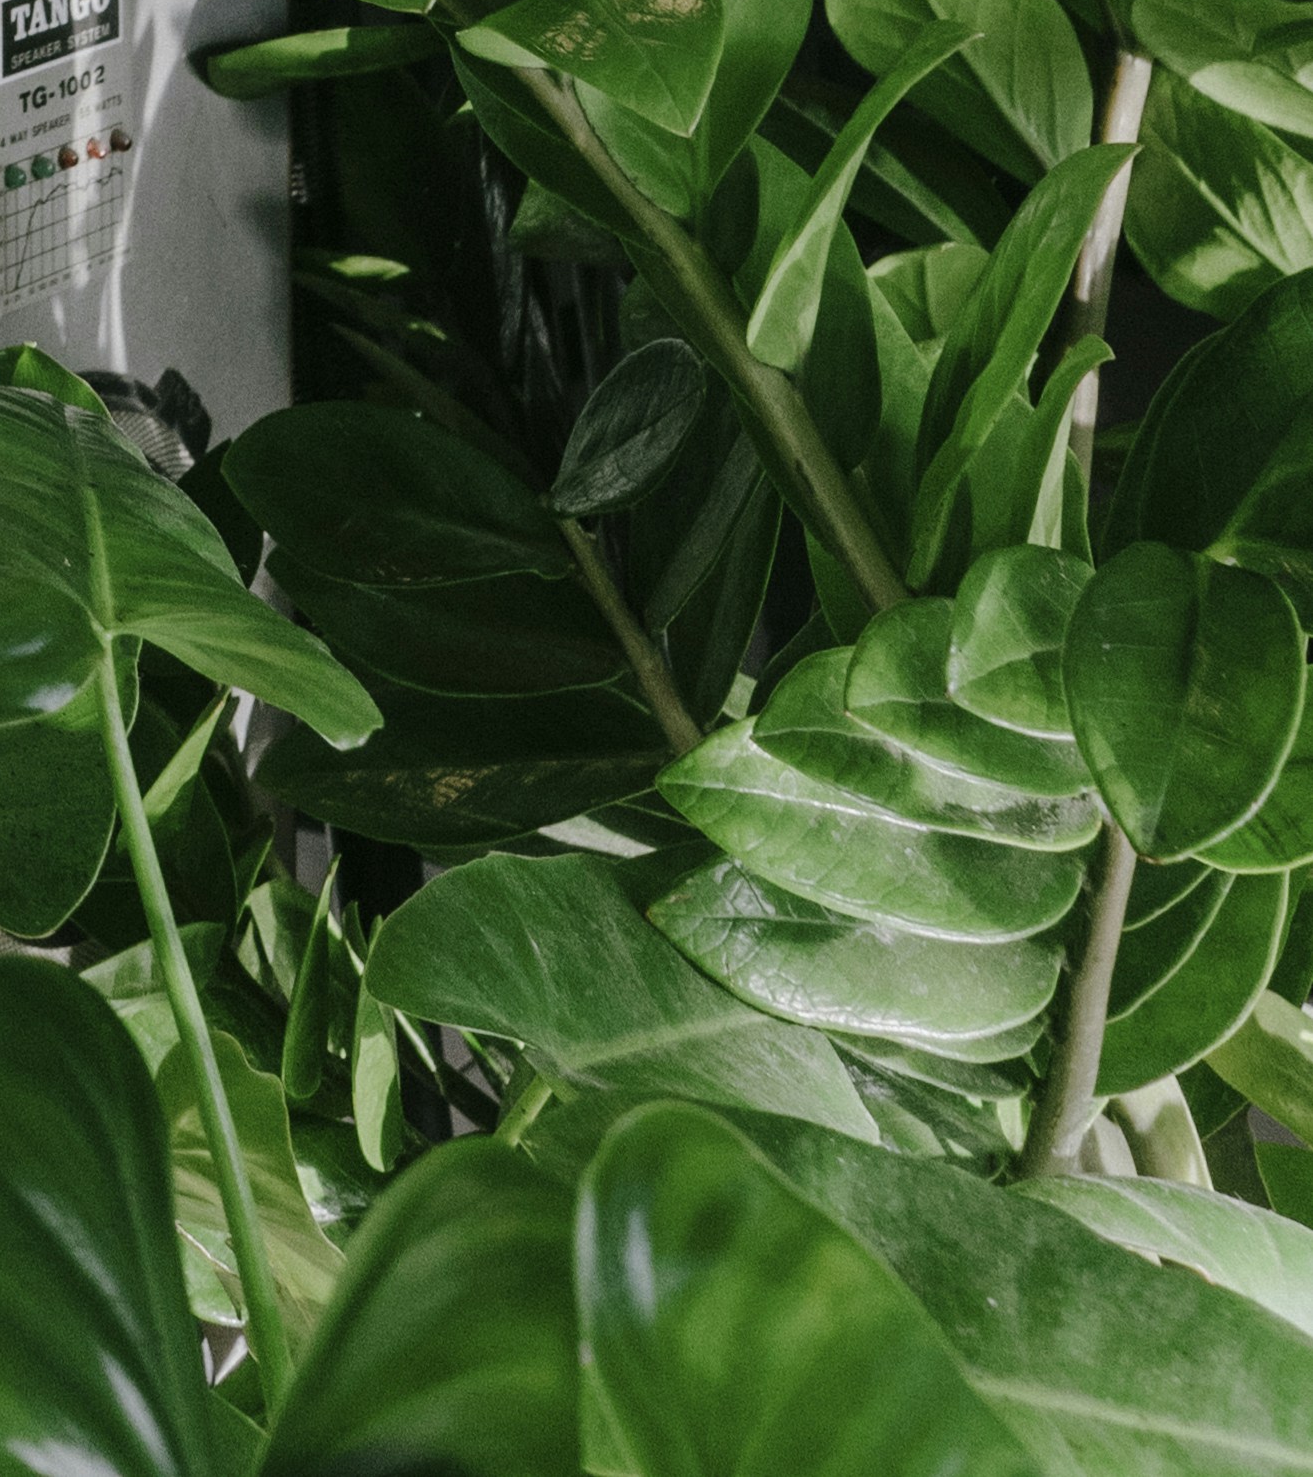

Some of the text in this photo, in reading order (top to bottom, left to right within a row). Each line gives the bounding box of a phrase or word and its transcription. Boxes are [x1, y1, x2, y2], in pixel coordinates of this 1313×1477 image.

[10, 22, 111, 70] SPEAKER SYSTEM
[18, 64, 106, 114] TG-1002
[32, 113, 71, 139] SPEAKER
